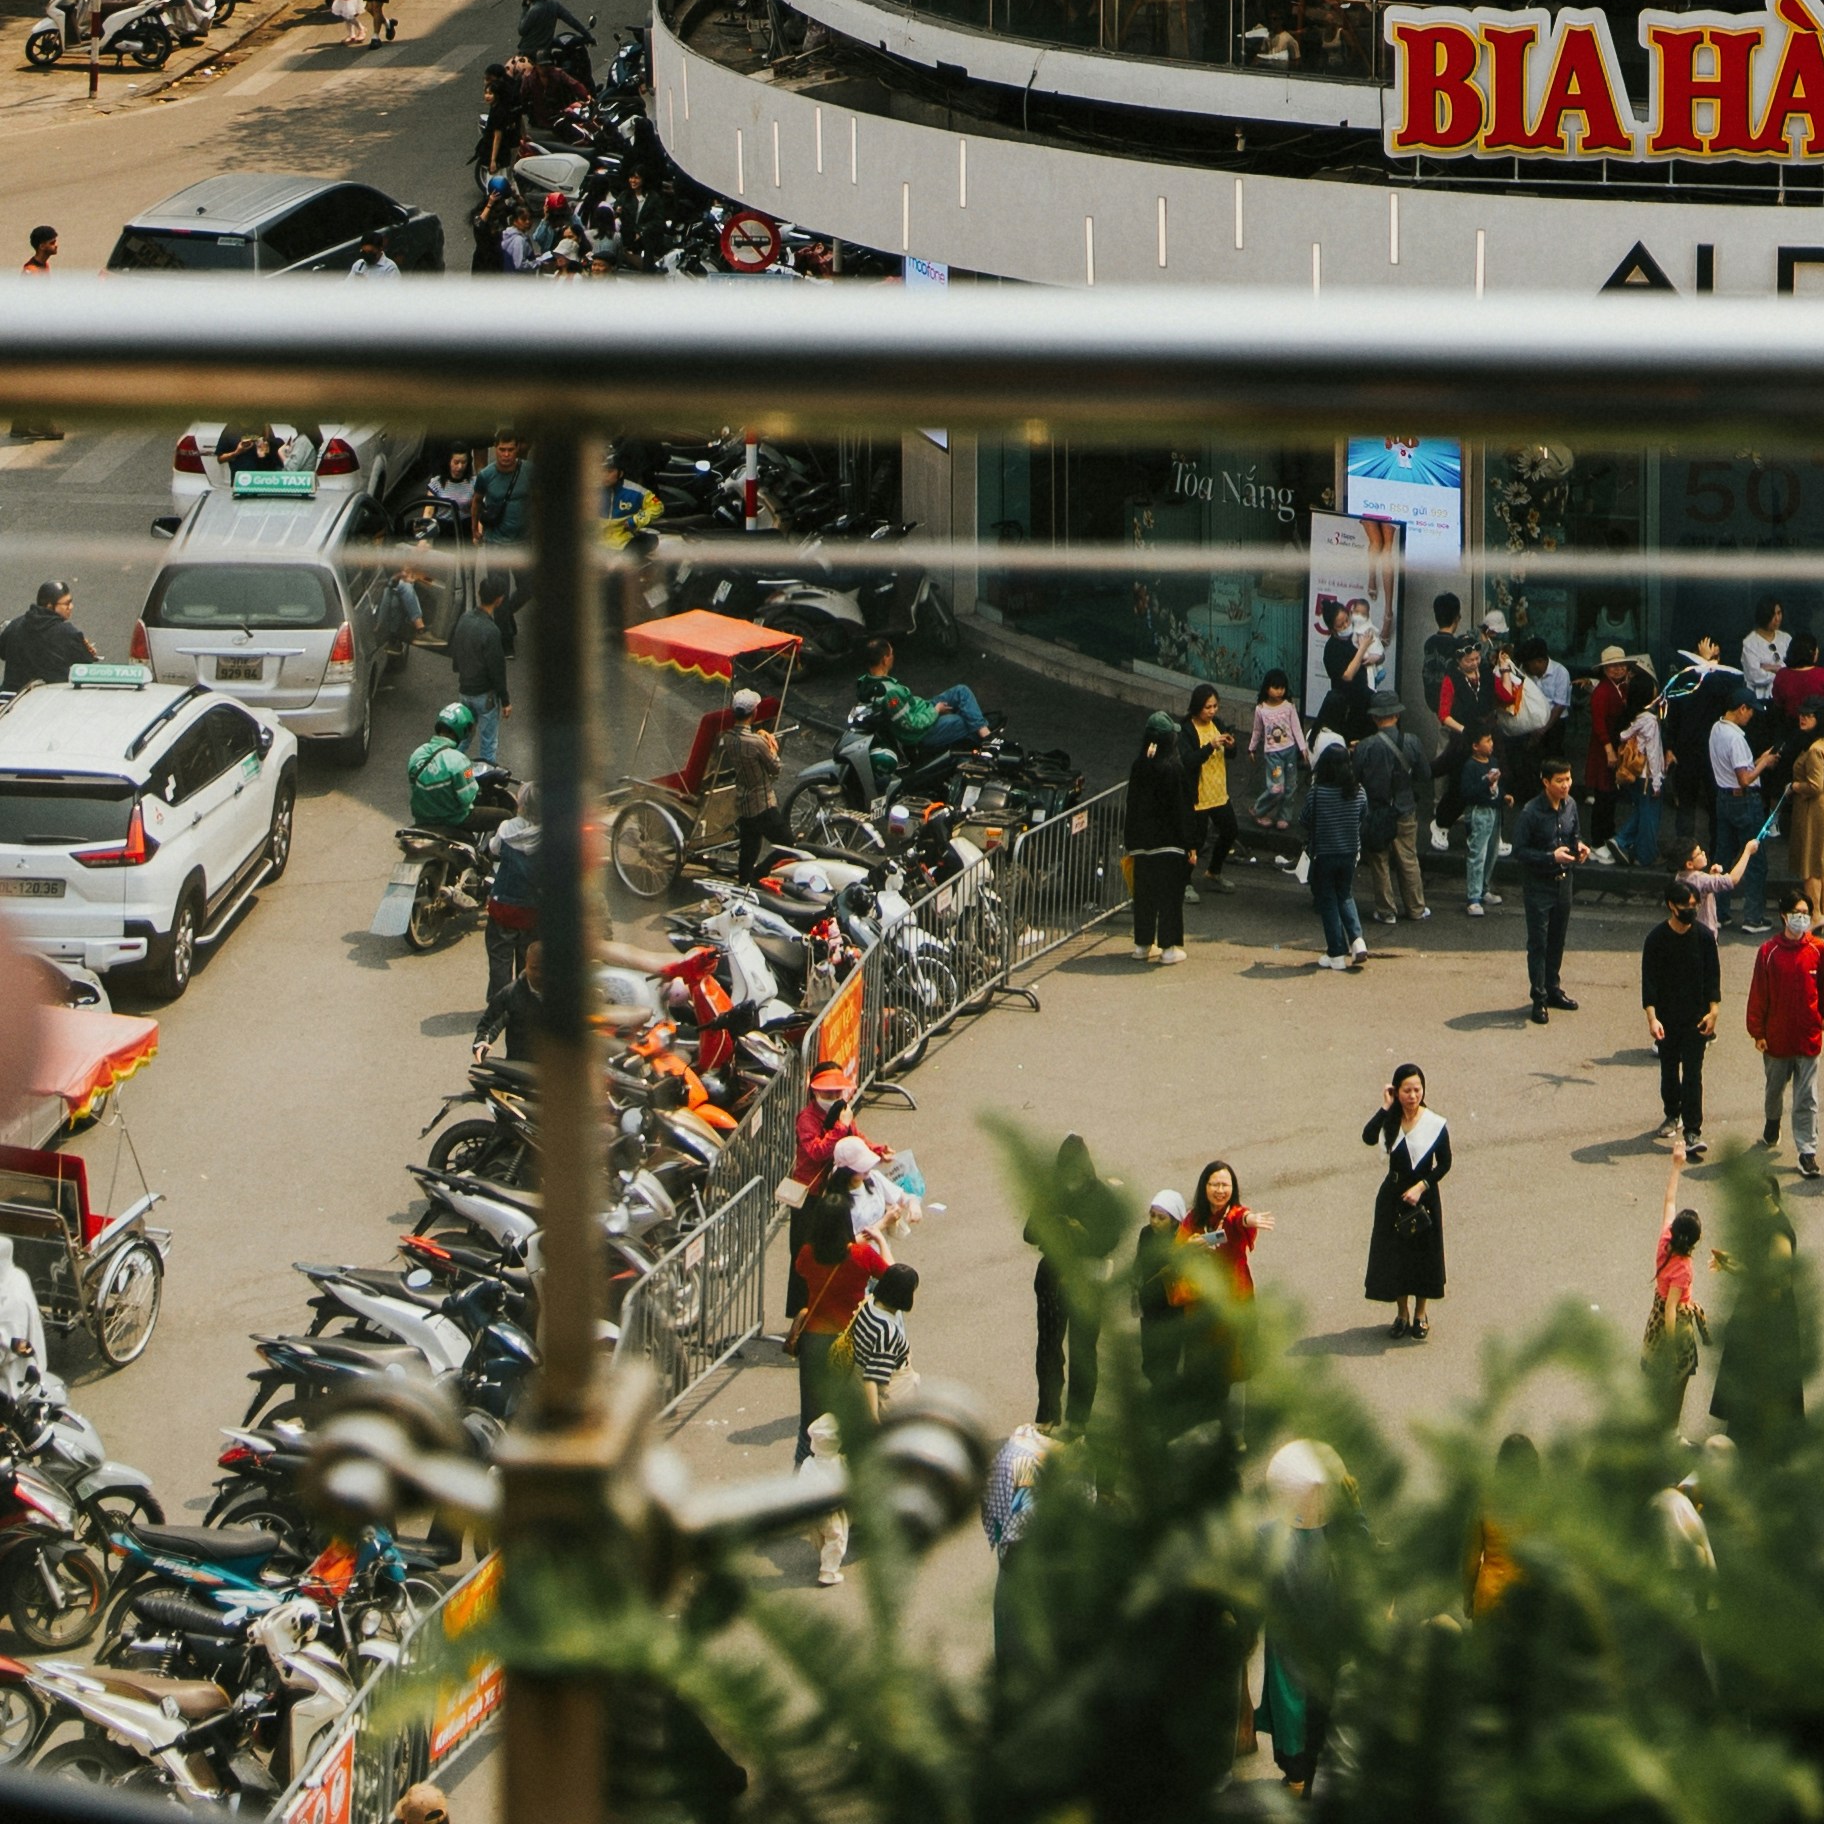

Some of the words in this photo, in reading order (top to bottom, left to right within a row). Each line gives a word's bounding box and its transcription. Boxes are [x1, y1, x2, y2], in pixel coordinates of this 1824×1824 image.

[1389, 15, 1637, 156] BIA
[253, 475, 279, 485] Grab
[281, 475, 311, 486] TAXI
[1222, 464, 1296, 522] Nắng
[114, 667, 143, 677] TAXI
